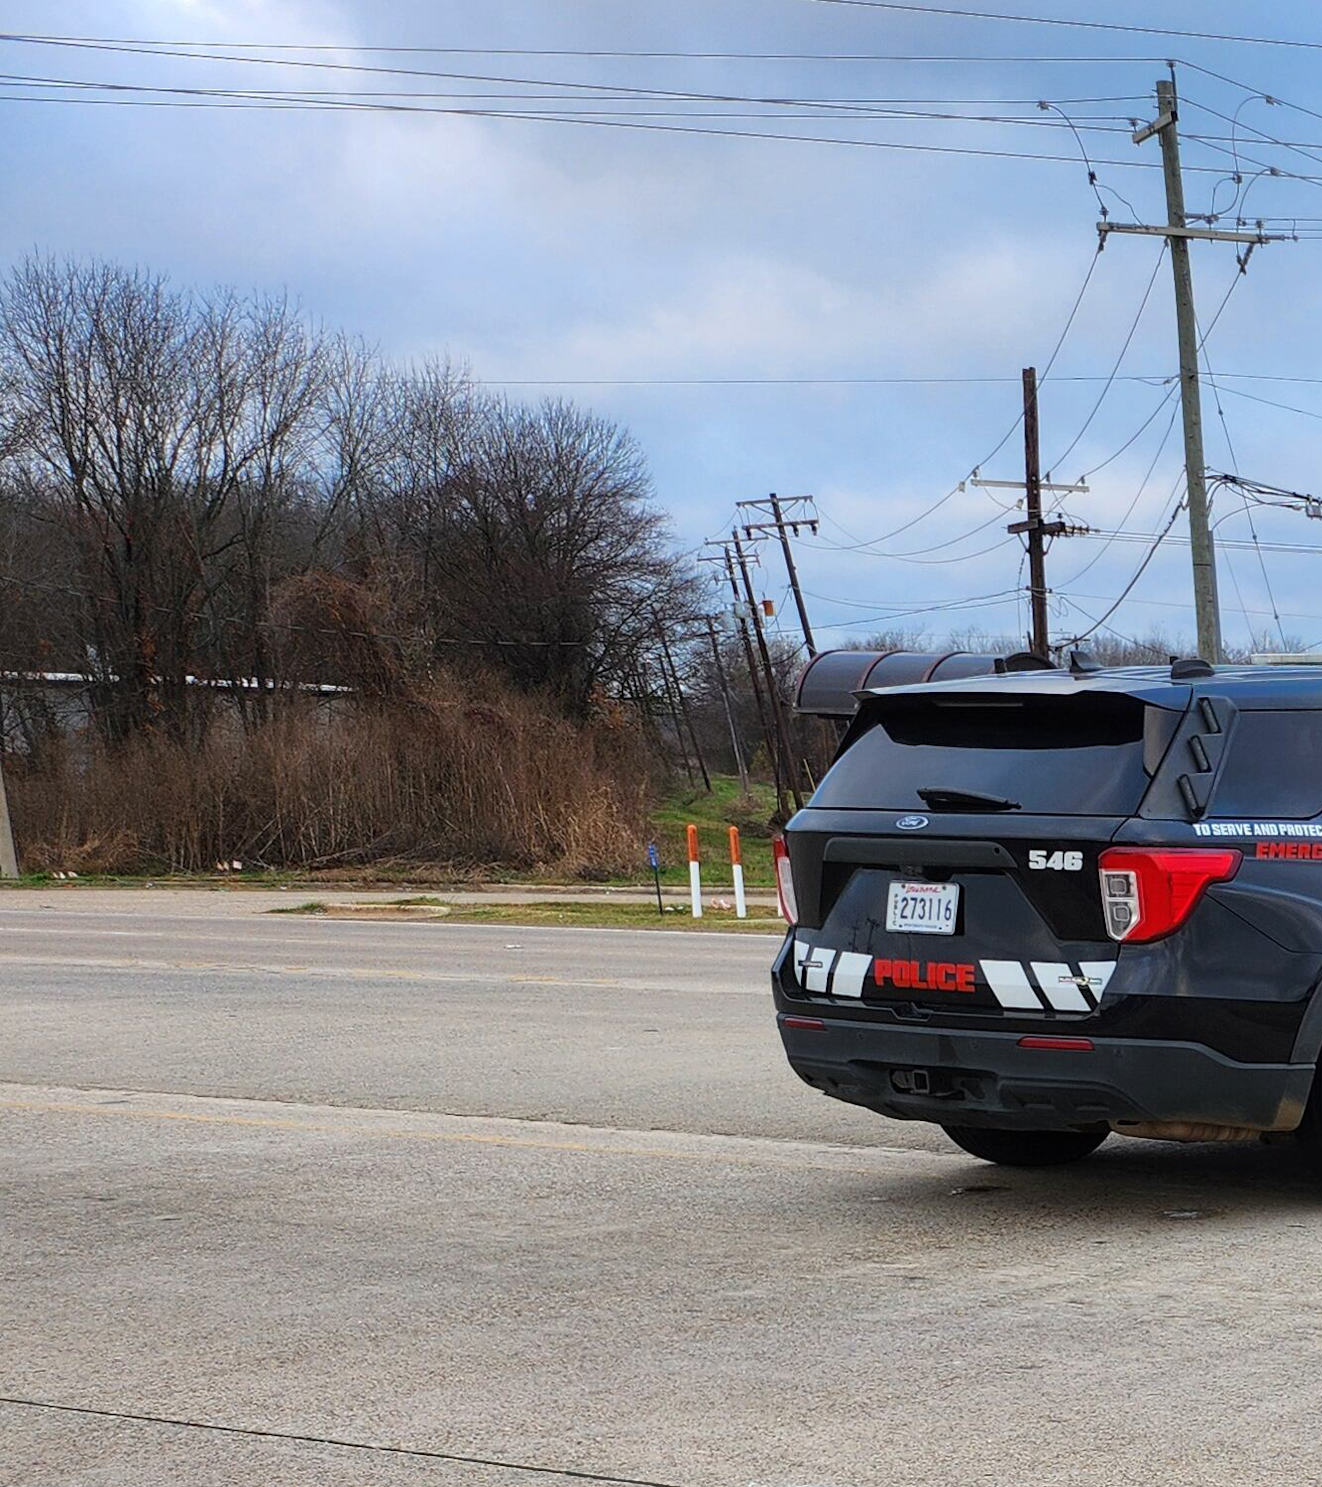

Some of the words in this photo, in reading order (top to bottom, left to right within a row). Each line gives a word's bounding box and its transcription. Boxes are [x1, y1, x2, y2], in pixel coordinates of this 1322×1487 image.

[1192, 823, 1210, 836] TO
[1213, 823, 1252, 836] SERVE
[1254, 823, 1278, 837] AND
[1029, 850, 1083, 871] 546
[900, 897, 952, 921] 273116
[874, 957, 976, 993] POLICE
